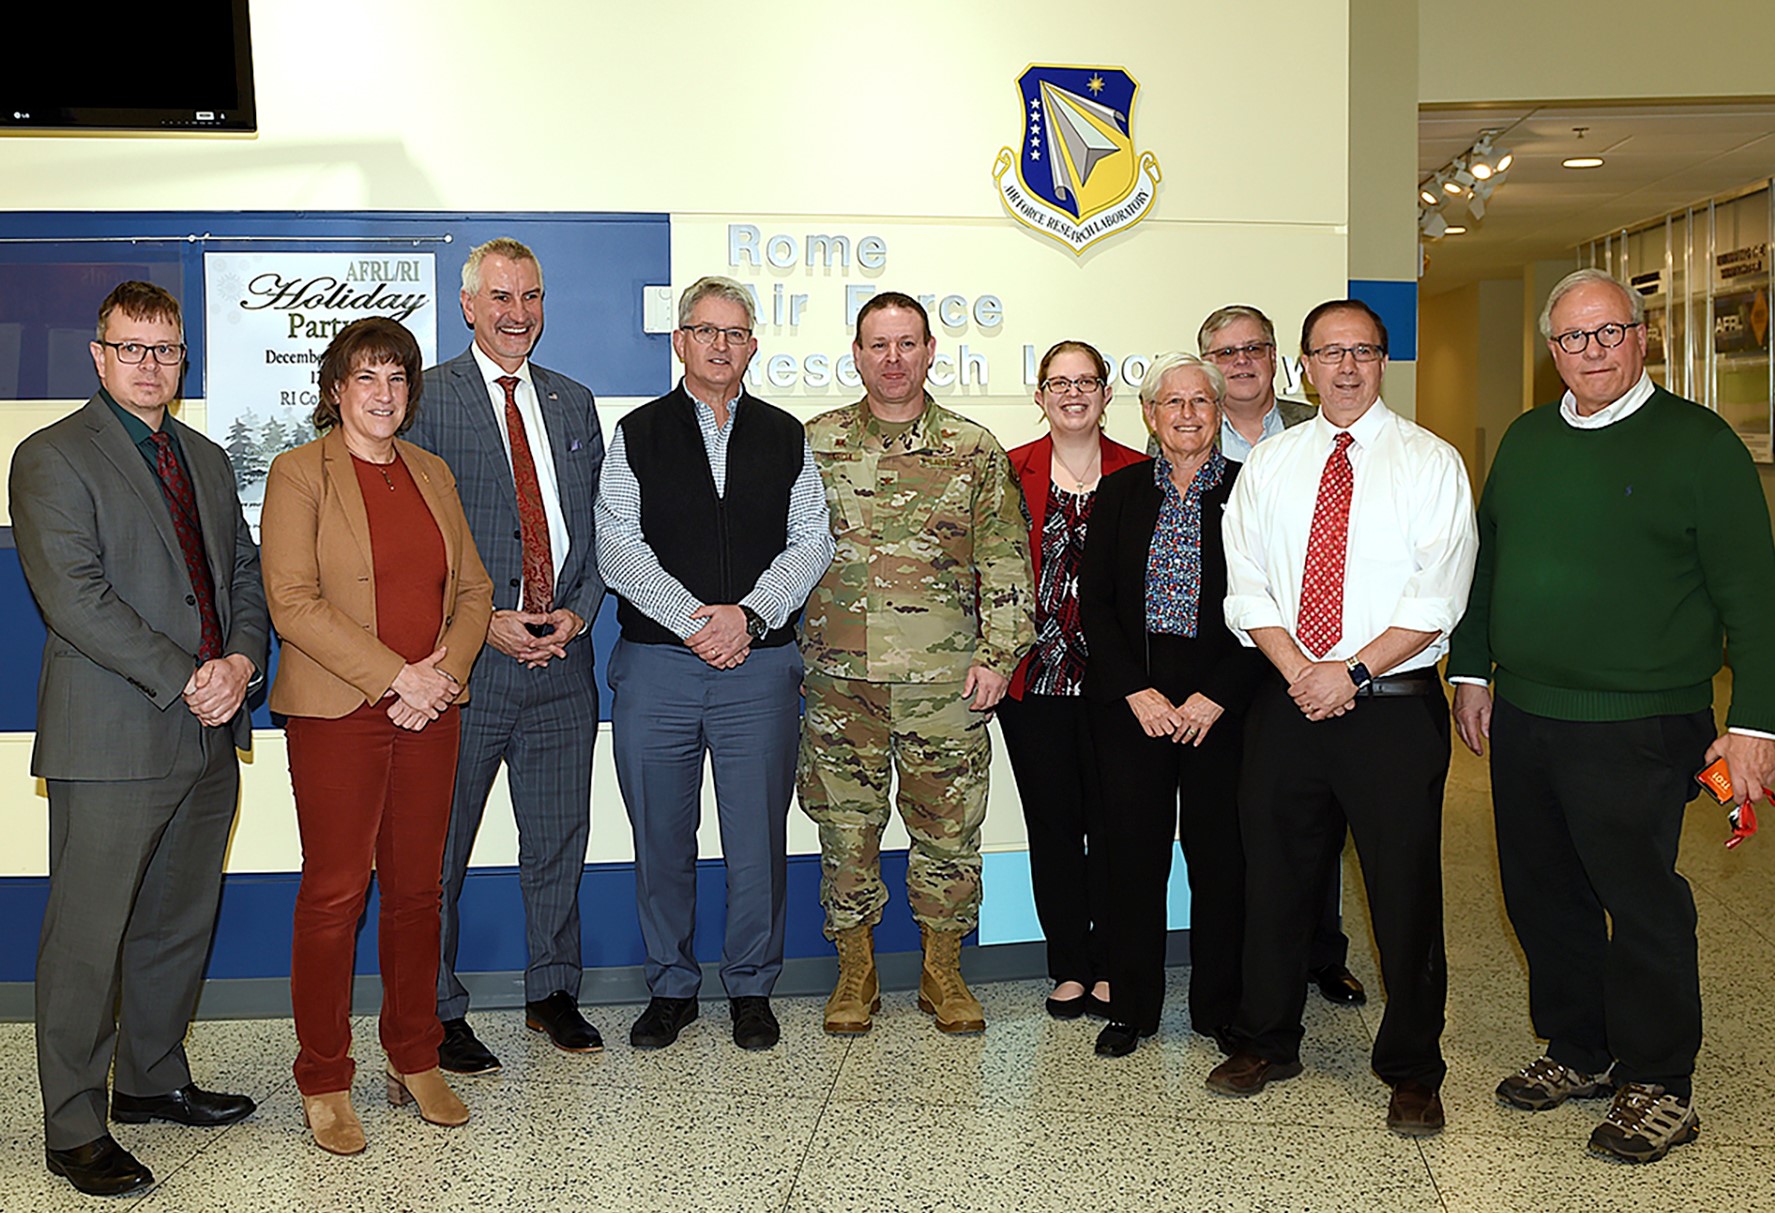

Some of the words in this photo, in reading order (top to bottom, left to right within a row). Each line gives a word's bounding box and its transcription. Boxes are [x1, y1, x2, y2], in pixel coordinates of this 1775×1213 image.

[1016, 197, 1046, 226] FORCE
[1046, 217, 1095, 242] RESEARCH
[1094, 188, 1150, 233] LABORATORY
[728, 224, 888, 269] Rome
[346, 261, 420, 282] AFRL/RI
[240, 273, 430, 322] Holiday
[845, 284, 1004, 329] Frce
[287, 313, 350, 338] Part
[1715, 314, 1743, 334] AFRL
[265, 347, 320, 364] Decemb
[280, 390, 295, 405] RI
